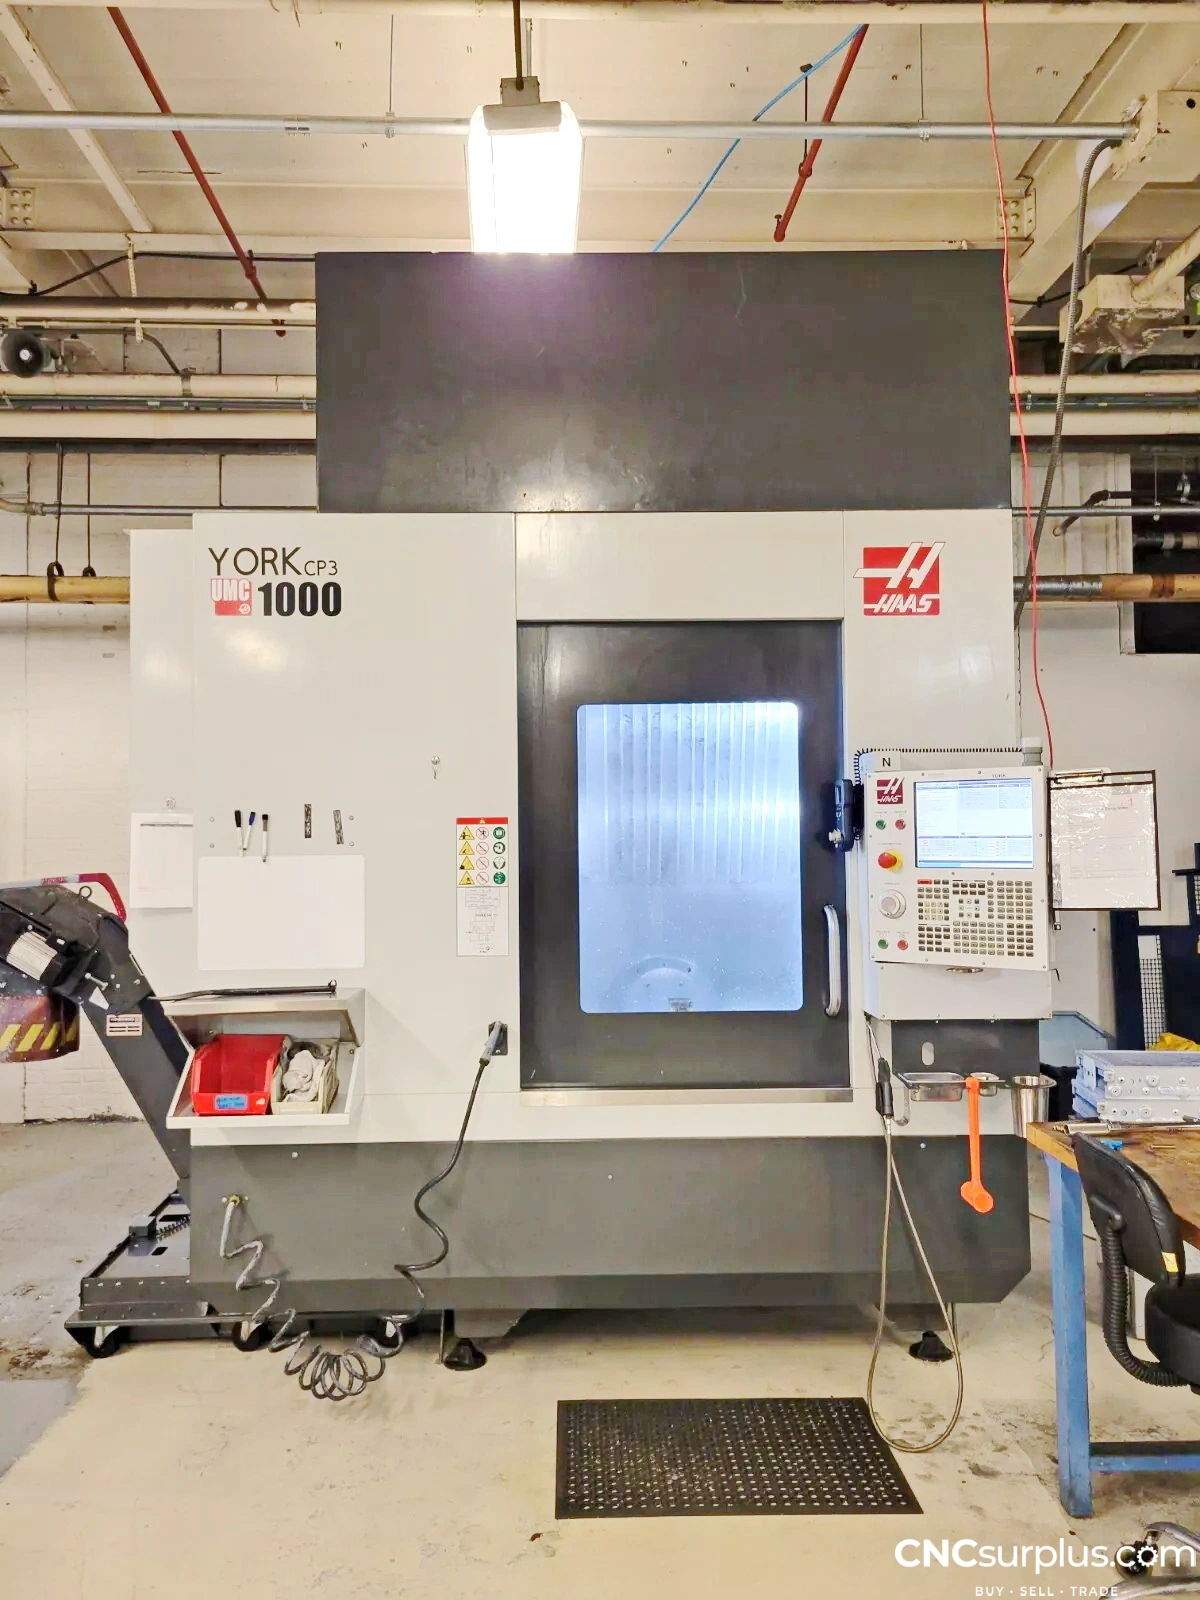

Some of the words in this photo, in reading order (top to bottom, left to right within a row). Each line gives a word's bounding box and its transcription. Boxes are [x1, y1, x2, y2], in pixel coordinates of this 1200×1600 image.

[208, 547, 302, 576] YORK
[304, 560, 338, 576] CP3
[210, 578, 251, 602] UMC
[257, 581, 342, 617] 1000
[863, 594, 940, 613] HAAS
[882, 757, 891, 767] N
